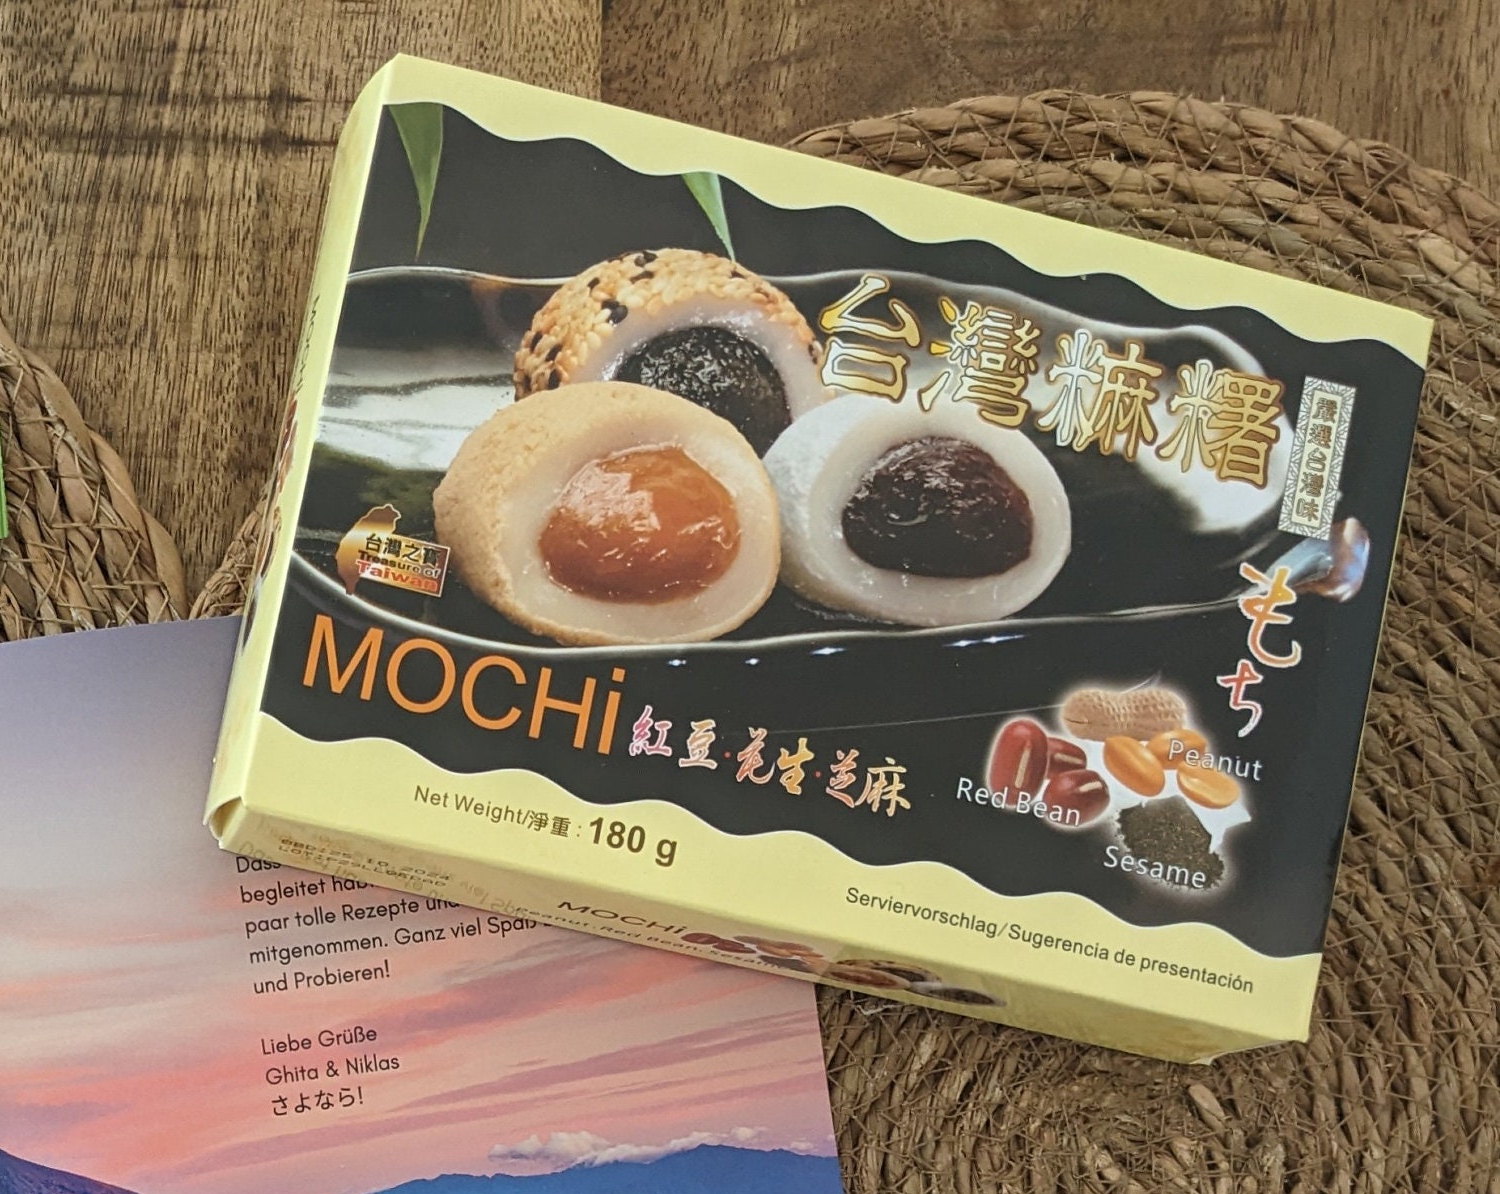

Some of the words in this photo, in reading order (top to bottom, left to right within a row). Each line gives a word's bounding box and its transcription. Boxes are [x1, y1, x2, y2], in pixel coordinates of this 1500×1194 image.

[356, 560, 438, 592] Taiwan
[358, 549, 421, 573] Treasure
[423, 568, 441, 579] of
[1216, 560, 1301, 738] もち
[1169, 739, 1263, 782] Peanut
[956, 777, 1008, 810] Red
[1016, 792, 1082, 827] Bean
[414, 785, 448, 809] Net
[588, 817, 647, 856] 180
[656, 833, 679, 866] g
[1103, 845, 1207, 889] Sesame
[240, 876, 326, 905] begleitet
[245, 917, 289, 939] paar
[296, 906, 336, 928] tolle
[343, 898, 419, 925] Rezepte
[250, 936, 388, 965] mitgenommen.
[395, 925, 446, 945] Ganz
[450, 917, 482, 938] viel
[254, 974, 288, 994] und
[294, 959, 390, 989] Probieren!
[1114, 943, 1135, 966] de
[1140, 950, 1254, 994] presentación
[261, 1032, 312, 1056] Liebe
[317, 1025, 378, 1049] Grüße
[265, 1062, 320, 1086] Ghita
[326, 1061, 340, 1078] &
[345, 1053, 400, 1075] Niklas
